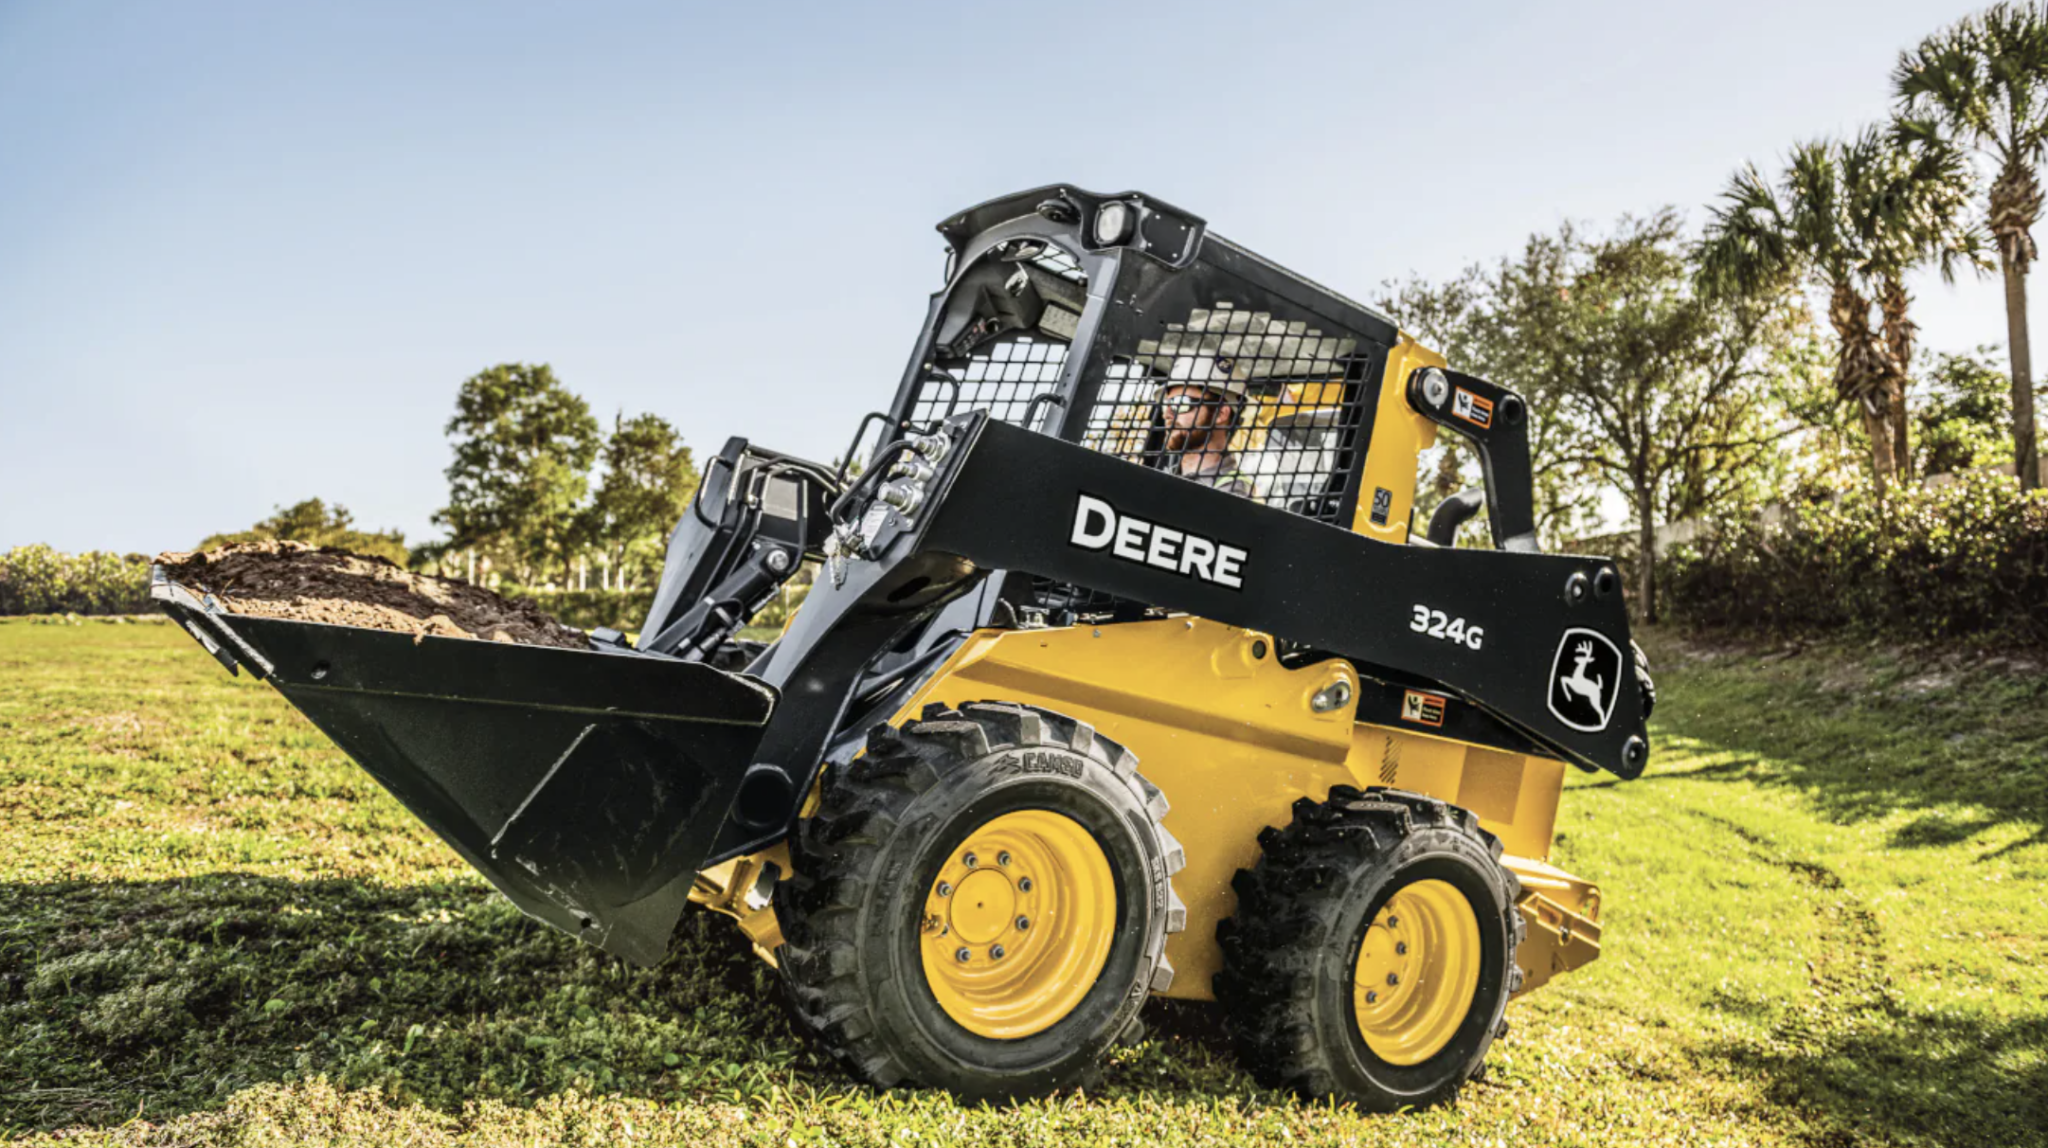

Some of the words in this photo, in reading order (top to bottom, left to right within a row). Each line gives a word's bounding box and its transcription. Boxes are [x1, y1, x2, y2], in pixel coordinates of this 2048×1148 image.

[1071, 494, 1247, 589] DEERE
[1410, 604, 1484, 650] 324G
[1023, 752, 1084, 779] CAMSO
